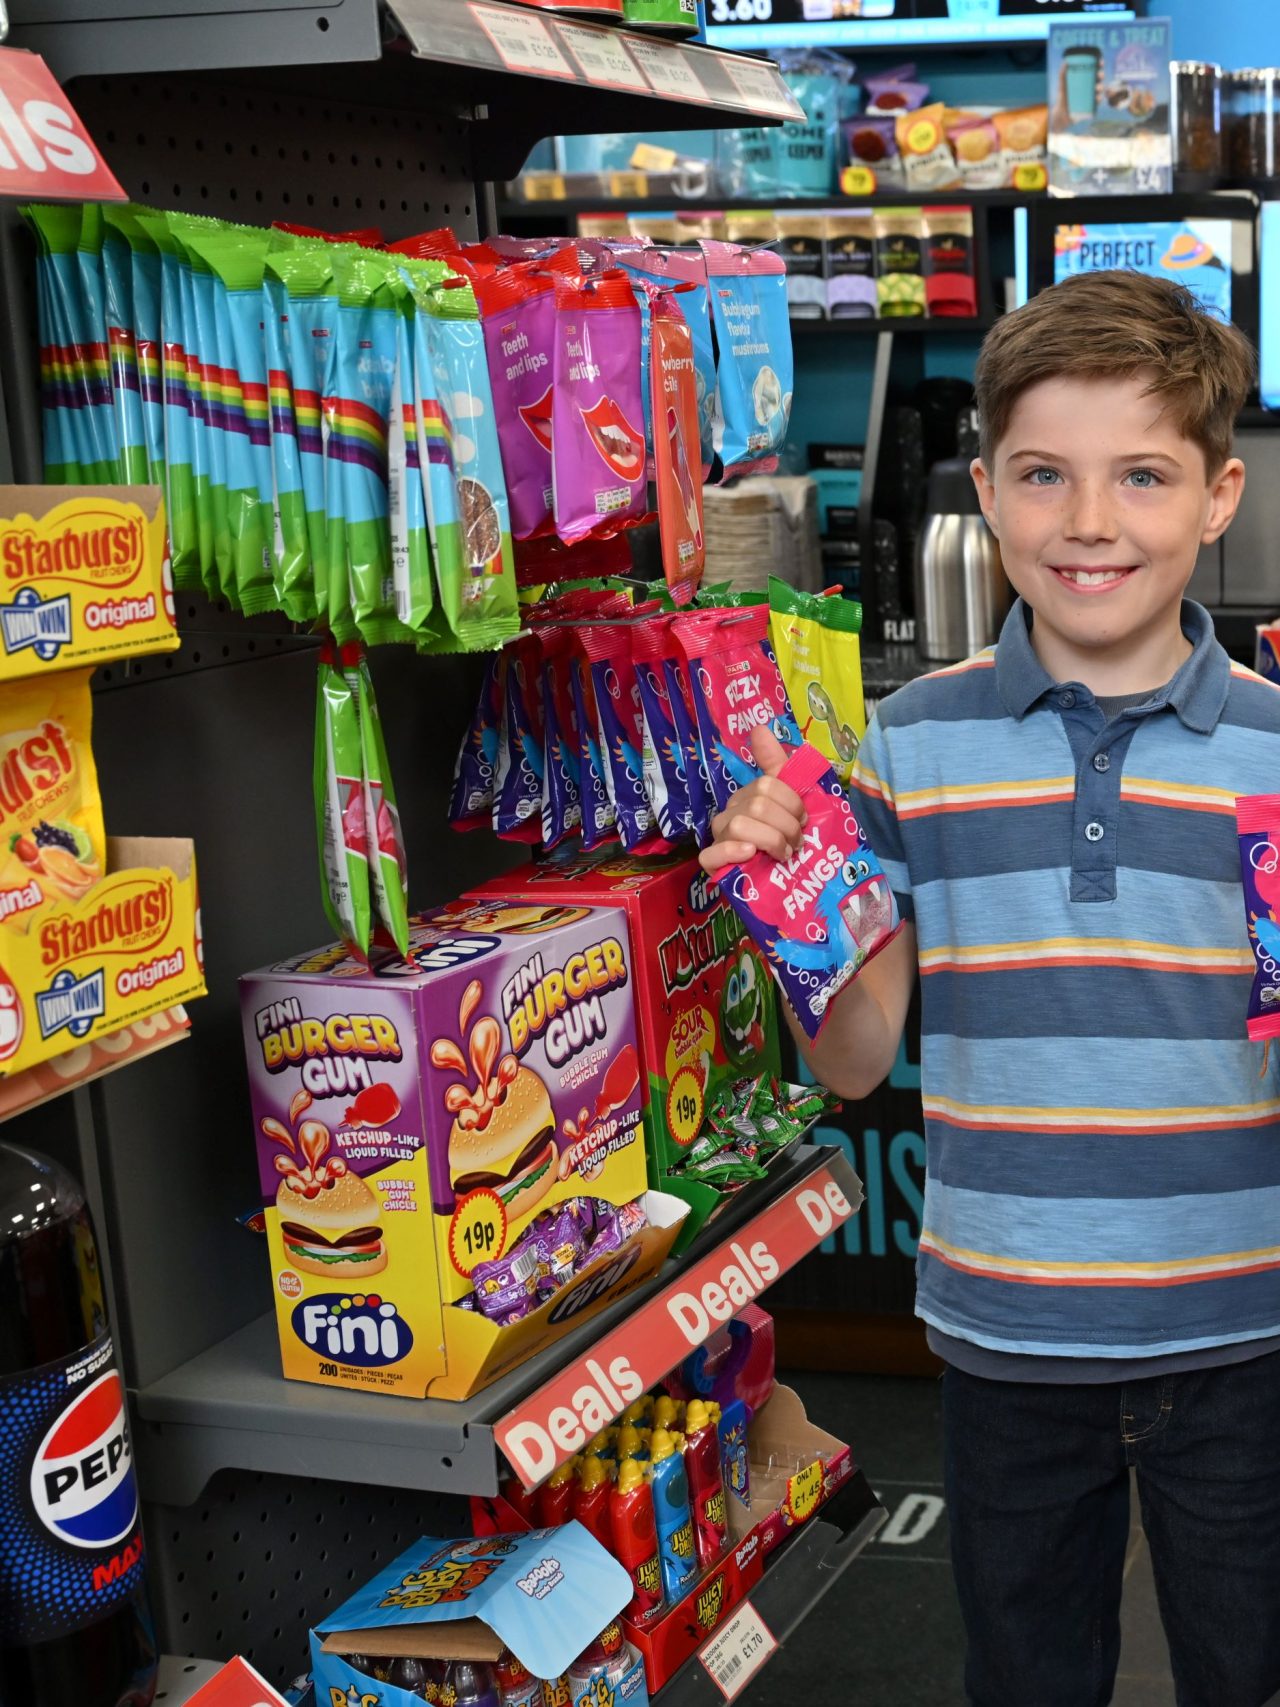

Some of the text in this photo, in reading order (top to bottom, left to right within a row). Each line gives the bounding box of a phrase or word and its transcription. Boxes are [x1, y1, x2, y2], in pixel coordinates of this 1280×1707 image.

[1080, 241, 1155, 267] PERFECT
[502, 332, 528, 357] Teeth
[567, 340, 583, 357] Teeth
[506, 352, 549, 381] and lips
[569, 363, 581, 381] and
[662, 358, 694, 373] wberry
[664, 376, 678, 392] cils
[3, 519, 138, 580] Starburst
[85, 595, 155, 628] Original
[884, 619, 916, 642] FLAT
[725, 674, 761, 708] FIZZY
[727, 697, 775, 736] FANGS
[0, 722, 72, 823] urst
[770, 827, 823, 890] FIZZY
[782, 845, 845, 919] FANGS
[0, 881, 42, 918] inal
[40, 883, 167, 966] Starburst
[117, 951, 183, 995] Original
[502, 953, 544, 1017] FINI
[508, 939, 626, 1050] BURGER
[257, 998, 302, 1037] FINI
[545, 997, 606, 1062] GUM
[672, 1005, 709, 1048] SOUR
[262, 1015, 400, 1068] BURGER
[302, 1058, 372, 1094] GUM
[560, 1048, 608, 1088] BUBBLE GUM
[571, 1065, 599, 1089] CHICLE
[676, 1096, 697, 1123] 19p
[345, 1147, 415, 1161] LIQUID FILLED
[578, 1130, 636, 1176] LIQUID FILLED
[378, 1180, 415, 1191] BUBBLE
[387, 1190, 410, 1200] GUM
[383, 1200, 417, 1212] CHICLE
[463, 1221, 495, 1254] 19p
[666, 1242, 780, 1346] Deals
[303, 1303, 399, 1359] Fini
[67, 1369, 86, 1386] NO
[319, 1362, 338, 1377] 200
[505, 1354, 644, 1484] Deals
[44, 1420, 131, 1505] PEPS
[796, 1466, 814, 1486] ONLY
[794, 1481, 821, 1510] £1.45
[517, 1557, 560, 1596] Bazooka
[698, 1578, 723, 1621] JUICY
[702, 1597, 720, 1625] DROP
[720, 1631, 731, 1645] JUICY
[730, 1620, 740, 1632] DROP
[743, 1633, 763, 1659] £1.70
